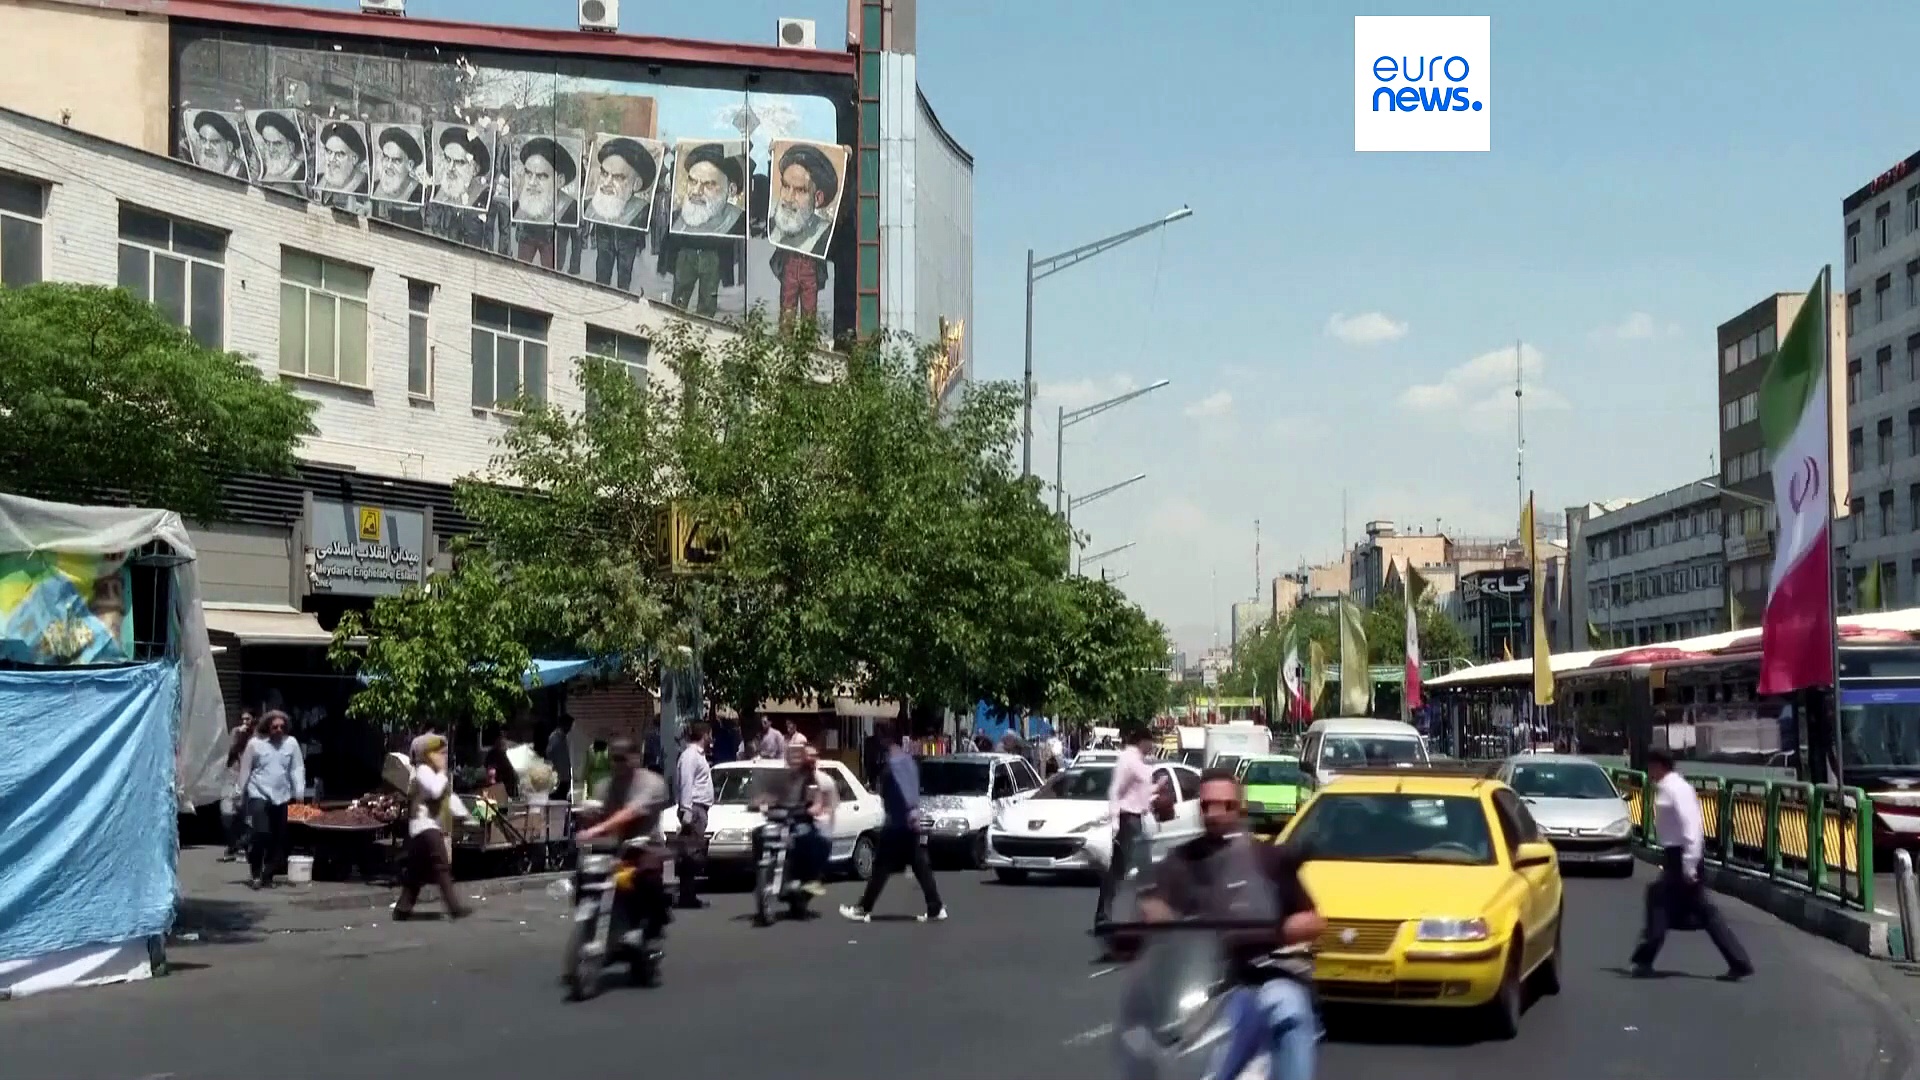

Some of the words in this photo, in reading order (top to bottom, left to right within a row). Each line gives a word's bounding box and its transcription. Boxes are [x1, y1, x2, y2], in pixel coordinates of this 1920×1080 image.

[316, 541, 354, 558] اسلامی
[356, 546, 388, 562] انقلاب
[391, 547, 420, 565] میدان
[315, 563, 352, 576] Meydan-e
[354, 566, 394, 580] Enghelab-e
